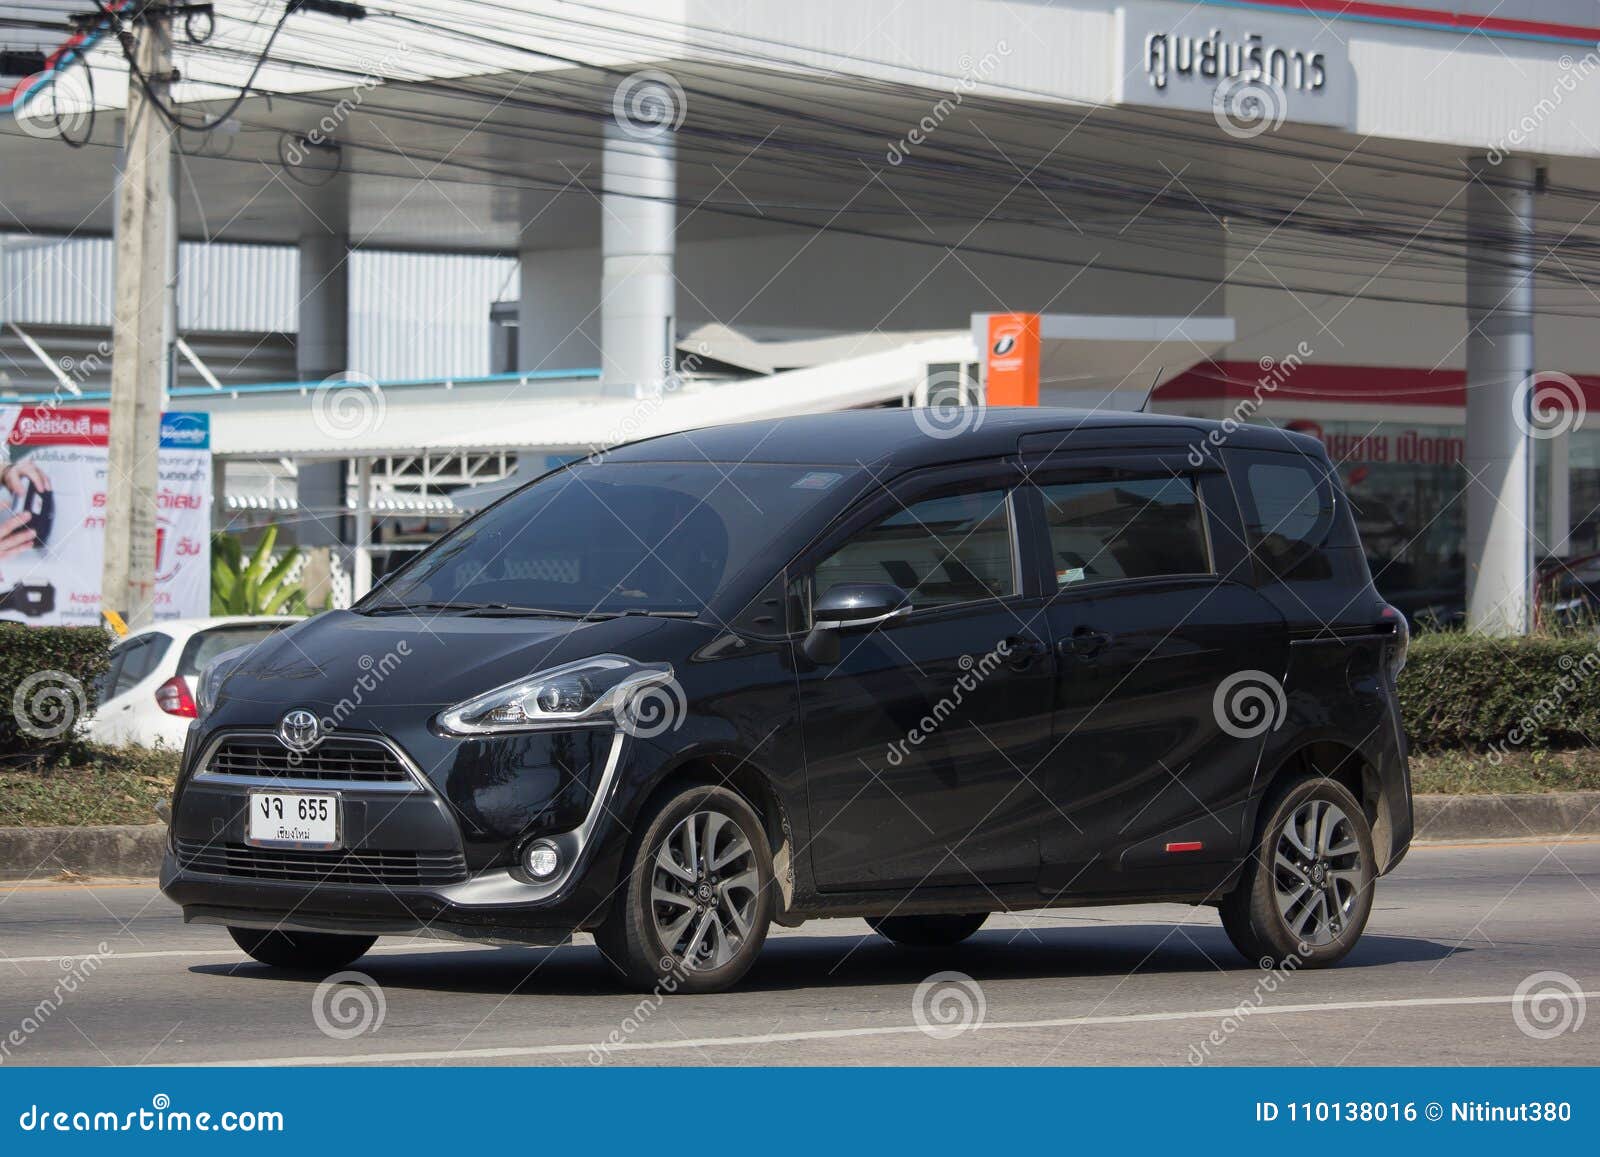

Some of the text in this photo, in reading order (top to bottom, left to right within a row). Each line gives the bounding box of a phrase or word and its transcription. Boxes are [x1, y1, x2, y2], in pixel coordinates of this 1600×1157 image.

[1144, 29, 1327, 91] ศูนย์บริการ
[260, 797, 328, 821] งจ 655
